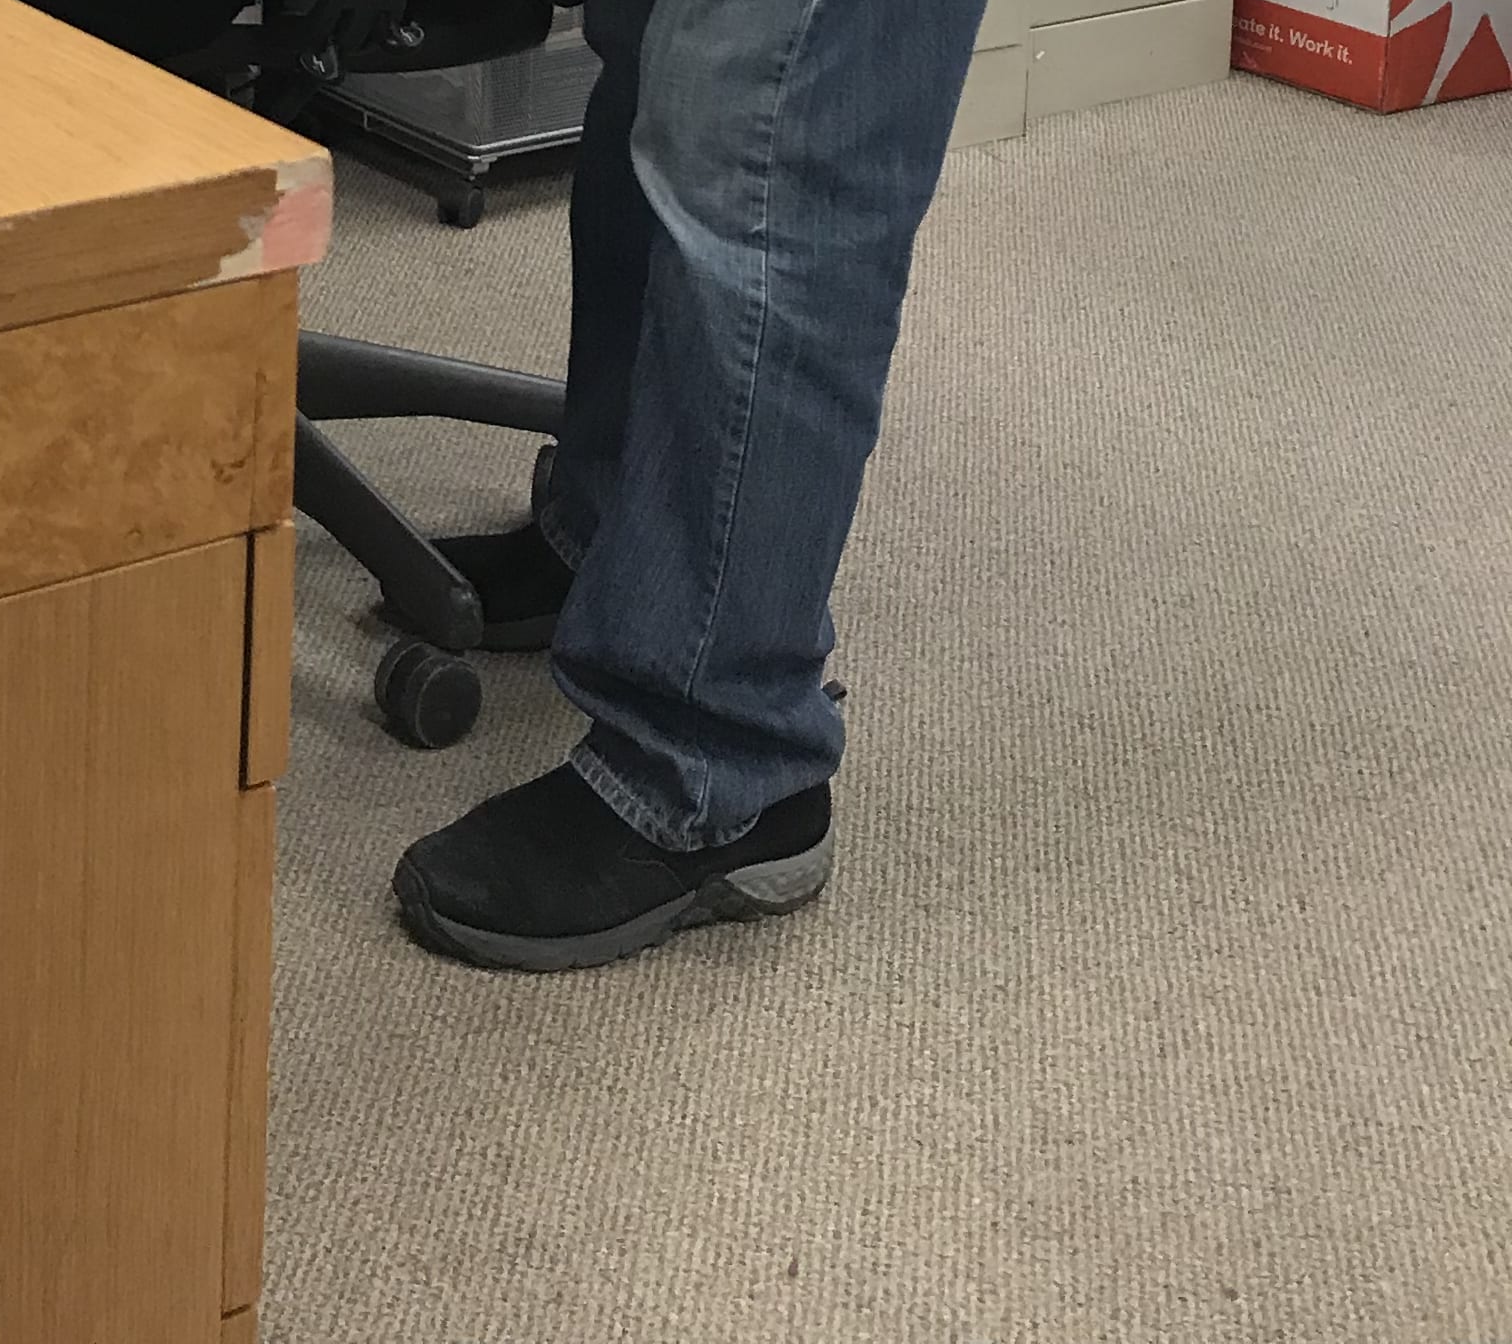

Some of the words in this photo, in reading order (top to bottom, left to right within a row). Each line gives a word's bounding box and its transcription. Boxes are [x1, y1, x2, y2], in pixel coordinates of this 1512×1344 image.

[1268, 18, 1285, 44] it.
[1289, 27, 1335, 59] Work
[1336, 44, 1354, 66] it.
